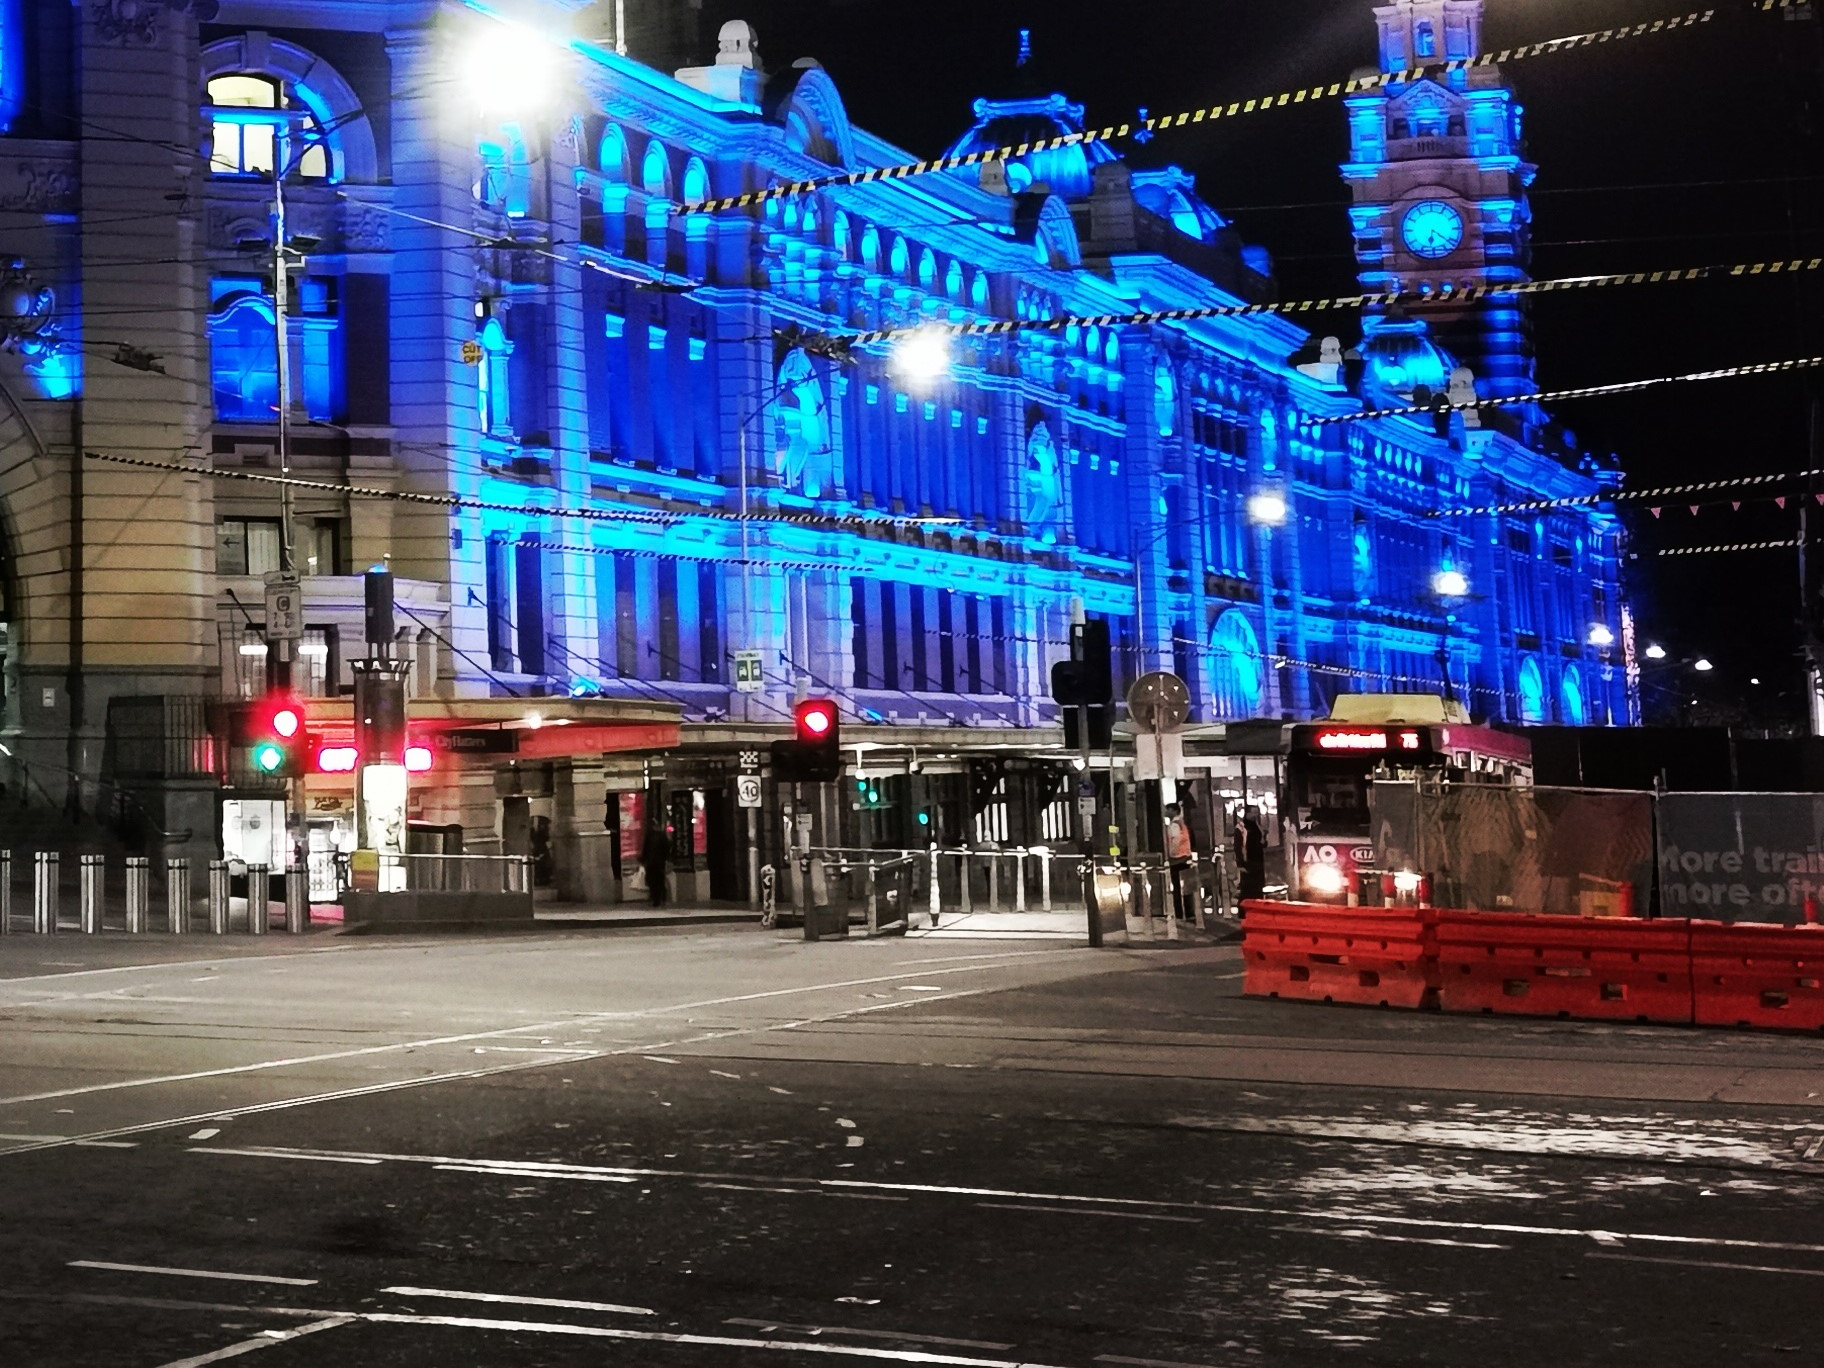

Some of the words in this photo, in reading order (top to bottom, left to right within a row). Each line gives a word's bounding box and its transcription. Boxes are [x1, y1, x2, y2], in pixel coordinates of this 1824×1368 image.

[742, 785, 758, 798] 40
[1753, 845, 1823, 873] trai
[1761, 877, 1823, 906] oft
